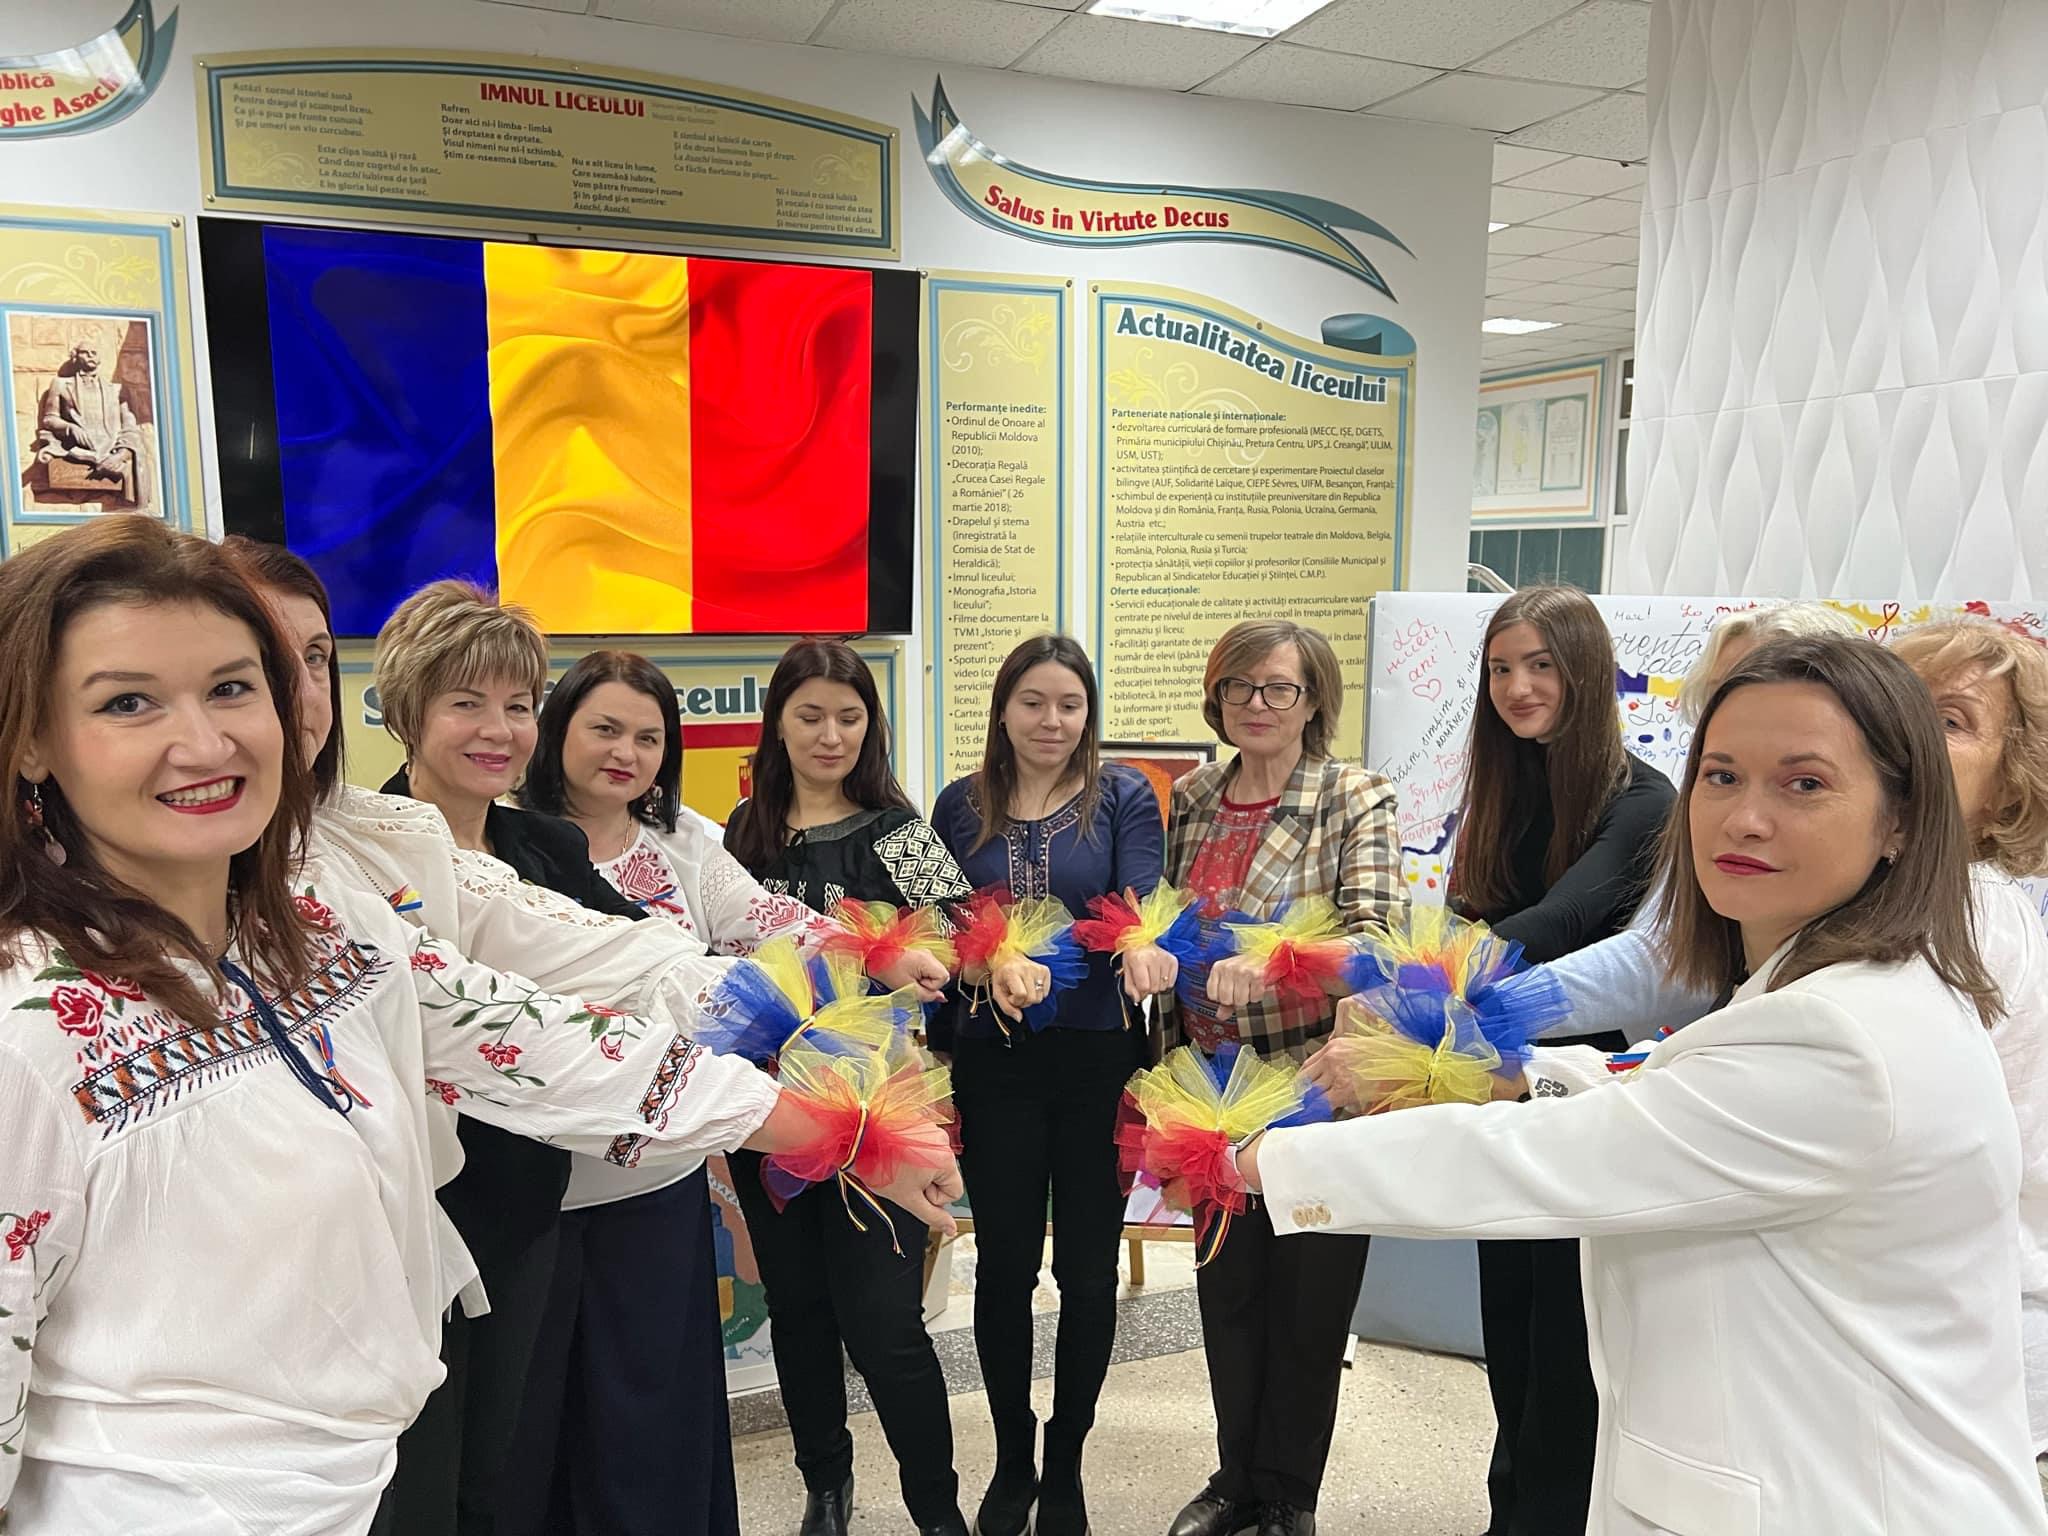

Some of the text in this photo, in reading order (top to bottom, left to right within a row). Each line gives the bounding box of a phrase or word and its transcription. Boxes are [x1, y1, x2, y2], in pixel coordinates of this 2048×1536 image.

[480, 82, 550, 106] IMNUL
[554, 90, 644, 118] LICEULUI
[984, 184, 1229, 232] Salus in Virtute Decus
[1116, 307, 1388, 402] Actualitatea liceului
[1010, 404, 1047, 414] inedite:
[1112, 408, 1286, 423] Parteneriate naționale și internaționale:
[951, 416, 1046, 428] Ordinul de Onoare al
[1116, 423, 1166, 433] dezvoltarea
[1168, 424, 1211, 434] curriculară
[1213, 425, 1224, 434] de
[1225, 425, 1258, 434] formare
[1259, 425, 1308, 437] profesională
[1310, 426, 1338, 438] (MECC,
[1355, 427, 1384, 438] DGETS,
[951, 431, 1038, 443] Republicii Moldova
[952, 445, 983, 456] (2010);
[952, 460, 1028, 472] Decorația Regală
[952, 474, 1046, 486] „Crucea Casei Regale
[1012, 490, 1024, 498] 26
[1116, 491, 1155, 501] schimbul
[1156, 491, 1167, 501] de
[1168, 491, 1212, 503] experiență
[1226, 492, 1266, 503] instituțiile
[1268, 492, 1327, 503] preuniversitare
[1328, 492, 1341, 501] din
[1343, 492, 1381, 503] Republica
[952, 503, 1012, 513] martie 2018);
[1116, 505, 1377, 515] Moldova și din România, Franța, Rusia, Polonia, Ucraina, Germania,
[952, 517, 992, 528] Drapelul
[1002, 518, 1030, 526] stema
[953, 530, 1017, 541] (înregistrată la
[1115, 532, 1147, 543] relațiile
[1148, 532, 1204, 541] interculturale
[1216, 532, 1248, 540] semenii
[1249, 531, 1282, 542] trupelor
[1283, 531, 1314, 540] teatrale
[1315, 531, 1328, 540] din
[1330, 531, 1365, 542] Moldova,
[1366, 530, 1392, 541] Belgia,
[953, 545, 1036, 554] Comisia de Stat de
[953, 559, 1001, 569] Heraldică);
[953, 573, 1016, 583] Imnul liceului;
[953, 586, 1037, 597] Monografia „Istoria
[1110, 586, 1200, 597] Oferte educaționale:
[1114, 599, 1144, 609] Servicii
[1146, 598, 1199, 610] educaționale
[1200, 598, 1212, 607] de
[1213, 597, 1243, 606] calitate
[1244, 597, 1251, 607] și
[1252, 596, 1286, 607] activități
[1288, 595, 1349, 604] extracurriculare
[954, 613, 1049, 623] Filme documentare la
[954, 628, 979, 636] TVM1
[981, 628, 1012, 638] „Istorie
[1114, 625, 1184, 636] gimnaziu și liceu;
[954, 656, 986, 666] Spoturi
[954, 669, 994, 680] video (cu
[954, 710, 984, 718] Cartea
[954, 722, 986, 732] liceului
[955, 736, 984, 744] 155 de
